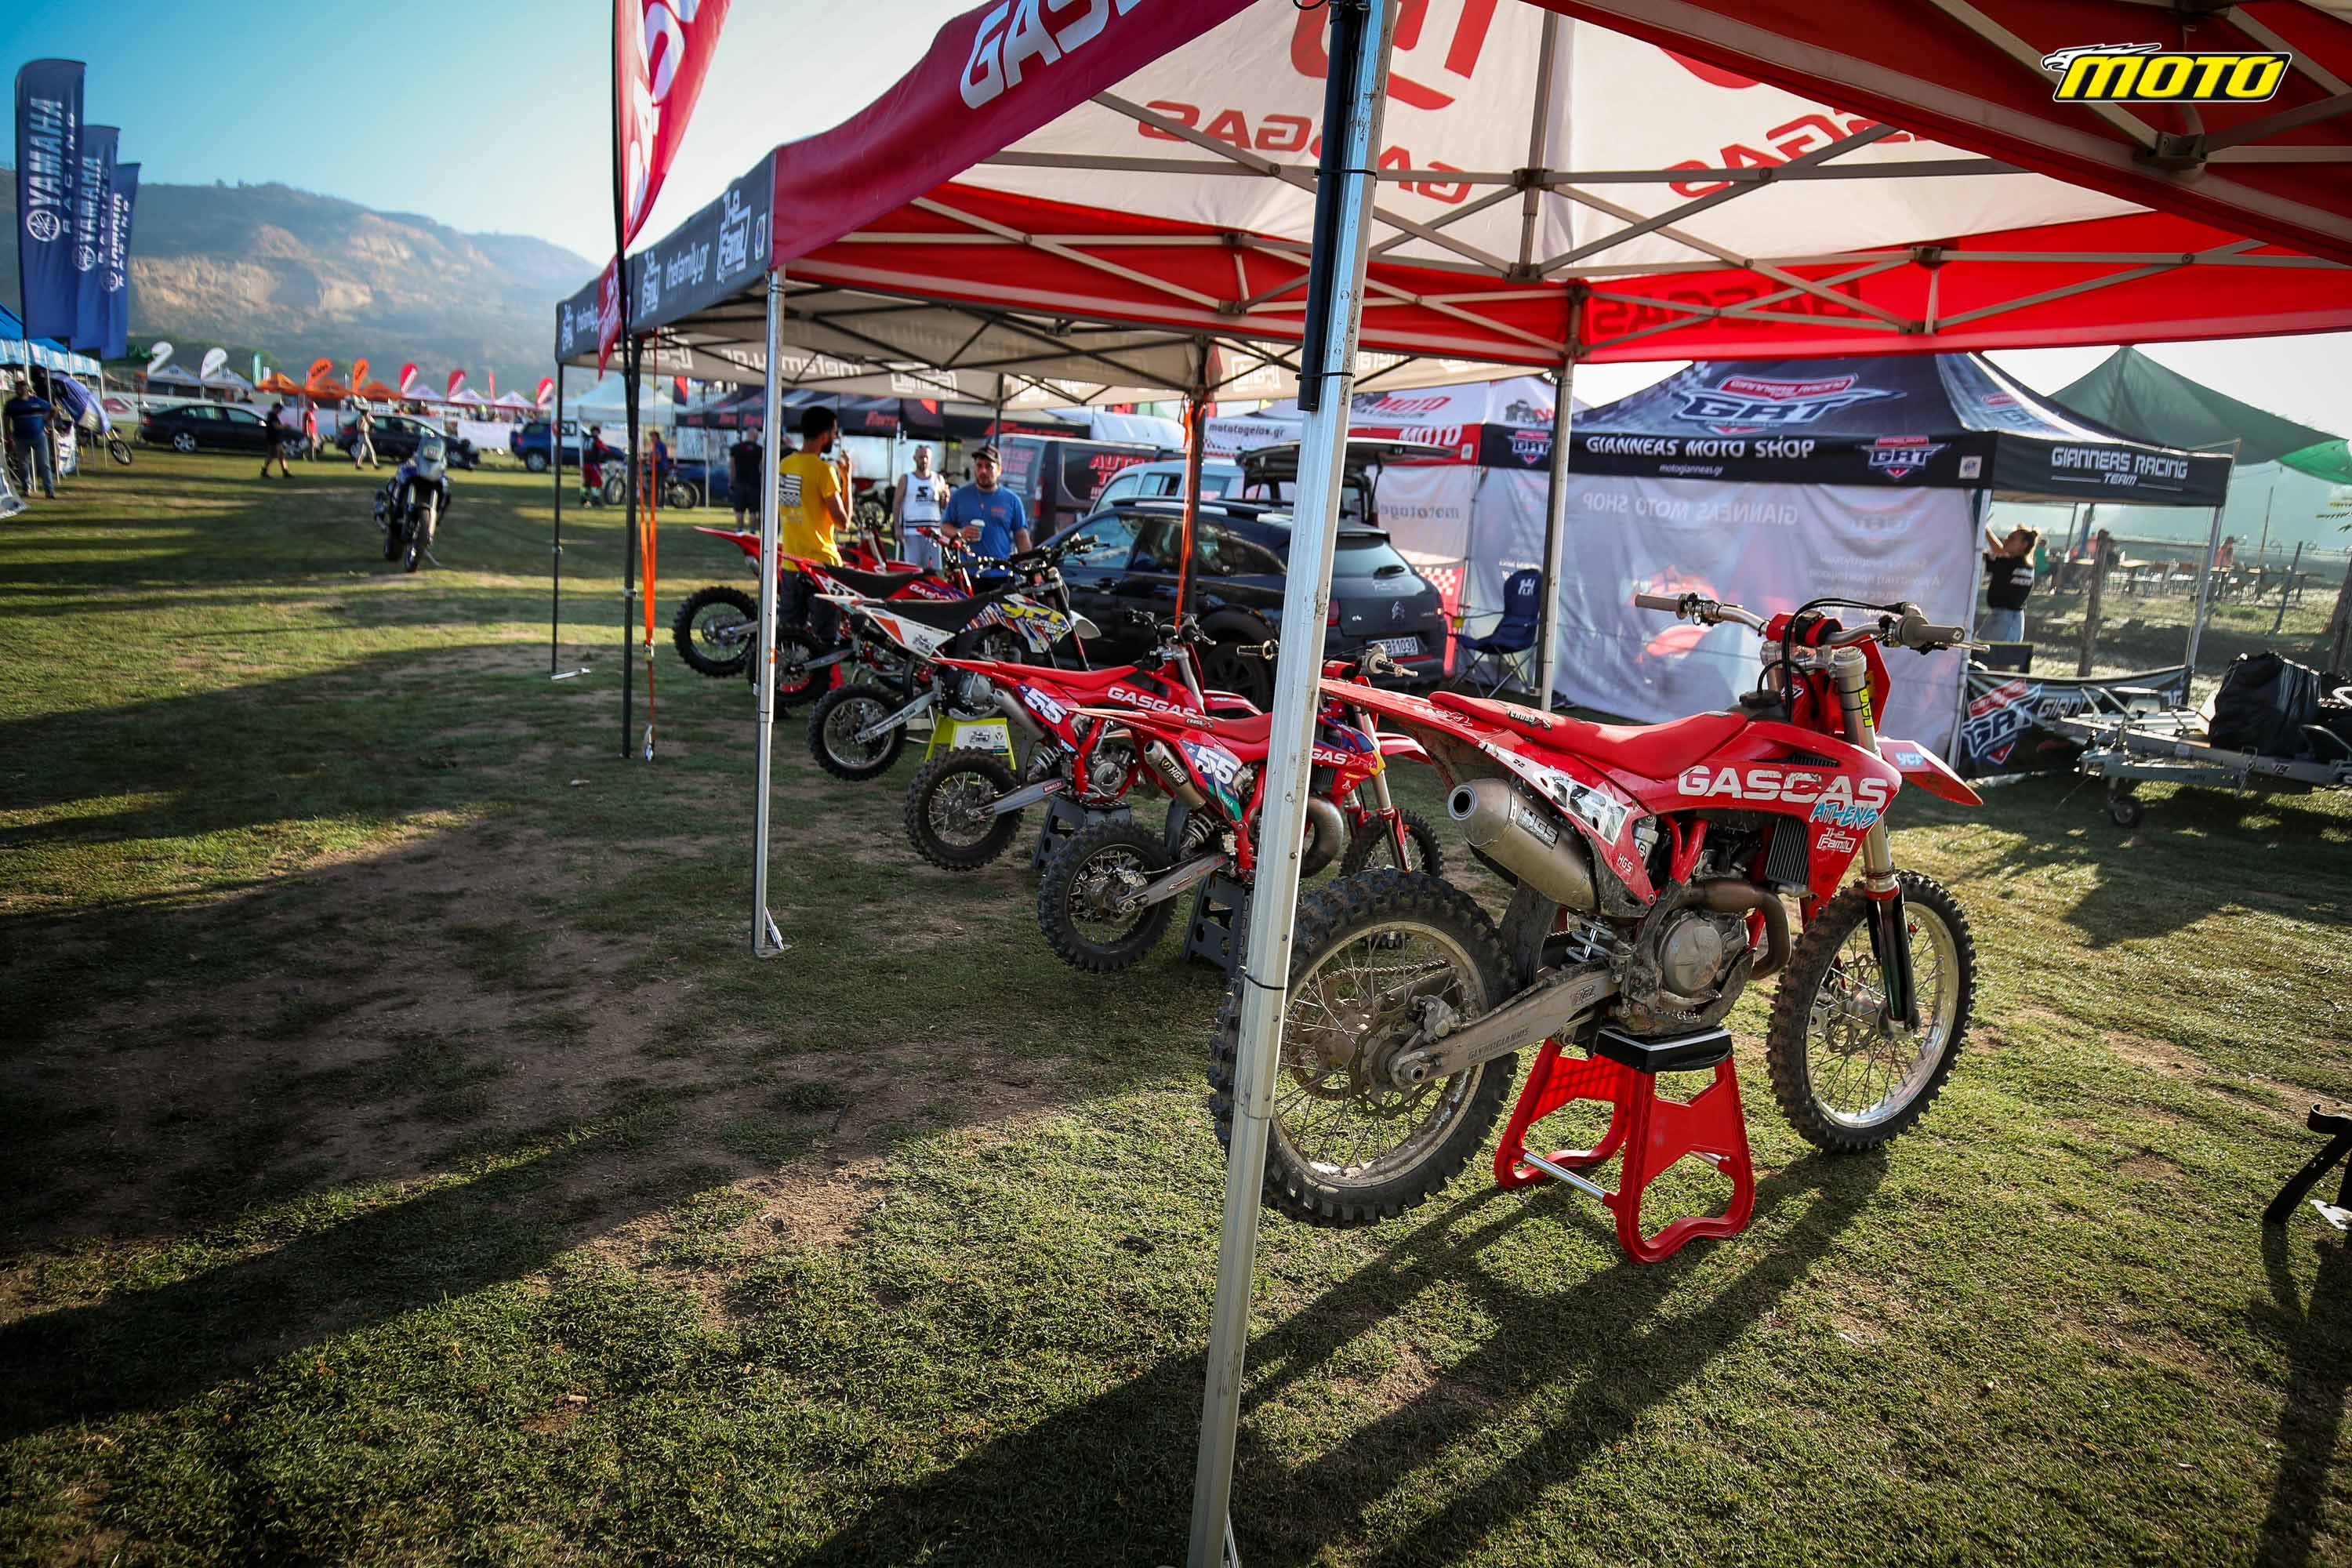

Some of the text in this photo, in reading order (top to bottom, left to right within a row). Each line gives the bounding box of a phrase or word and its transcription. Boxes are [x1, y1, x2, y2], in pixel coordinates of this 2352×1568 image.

[960, 0, 1139, 109] GAS
[28, 97, 63, 207] YAMAHA
[79, 156, 100, 243] YAMAHA
[1586, 436, 1816, 459] GIANNEAS MOTO SHOP
[1659, 463, 1724, 477] motogianneas.gr
[2103, 472, 2139, 486] TEAM
[2134, 454, 2188, 480] RACING
[1167, 765, 1187, 784] HGS
[1195, 746, 1237, 784] 55
[1677, 765, 1888, 810] GASGAS
[1809, 802, 1879, 831] ATHENS
[1819, 837, 1853, 851] Family
[1826, 827, 1846, 837] The
[1617, 853, 1634, 873] HGS
